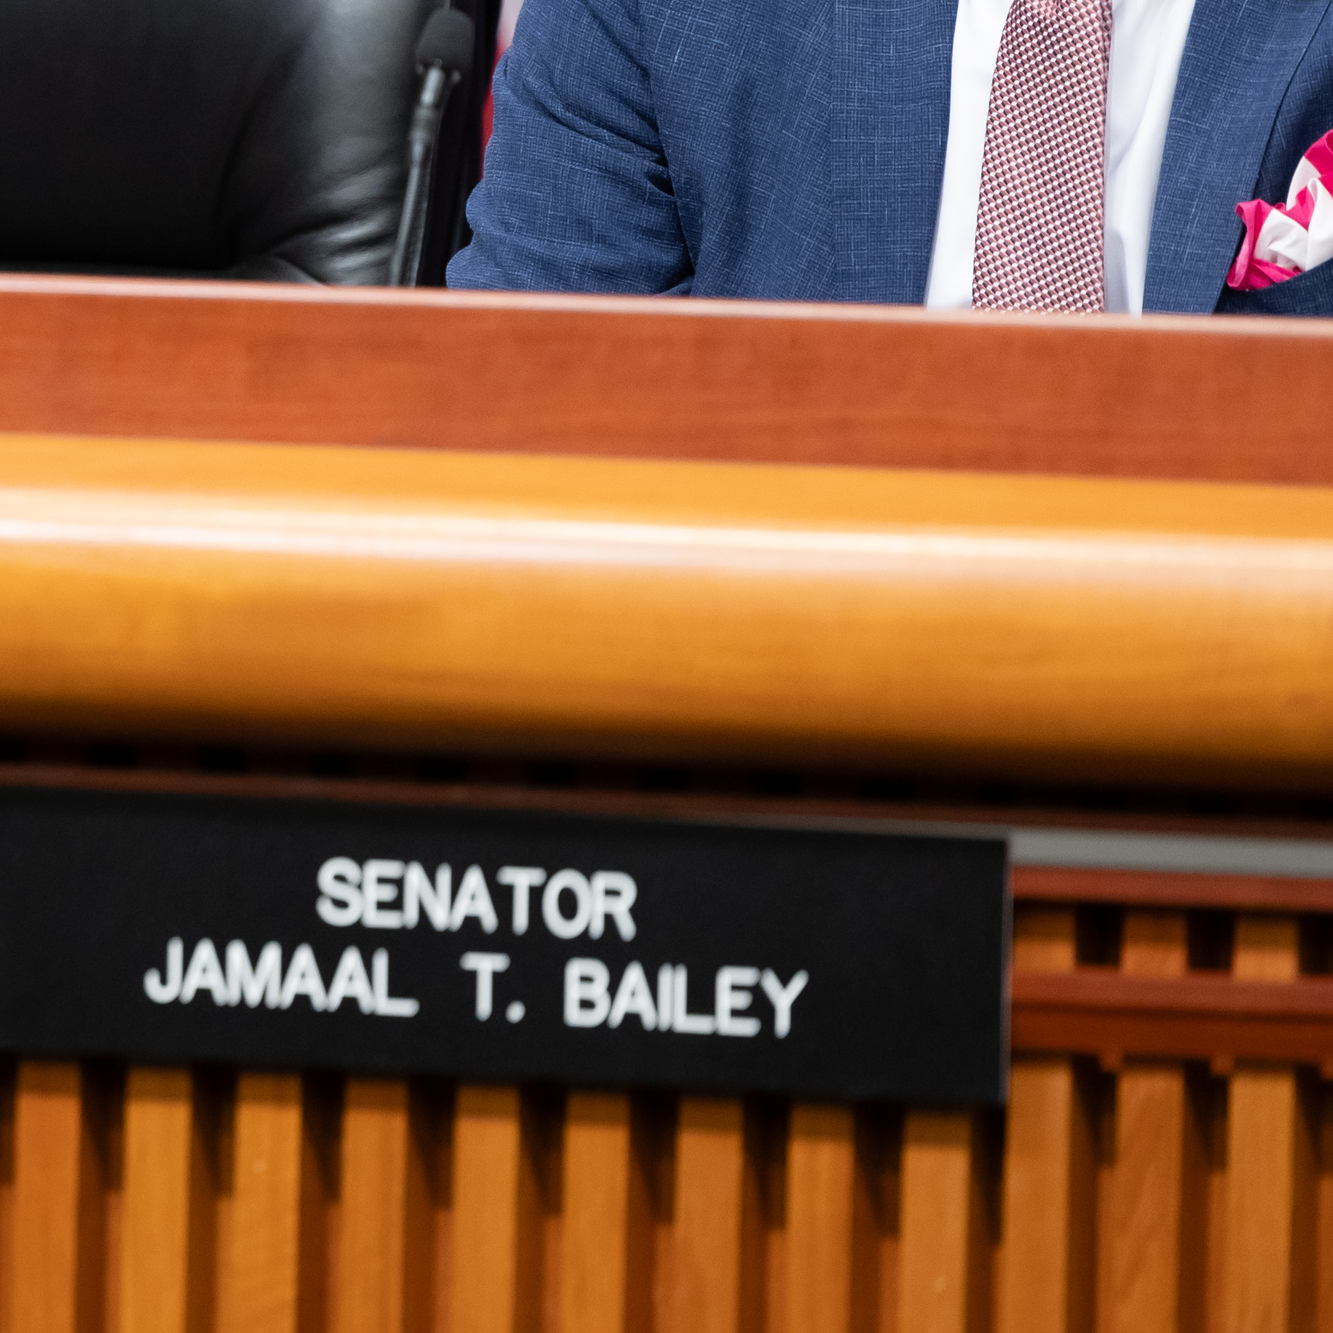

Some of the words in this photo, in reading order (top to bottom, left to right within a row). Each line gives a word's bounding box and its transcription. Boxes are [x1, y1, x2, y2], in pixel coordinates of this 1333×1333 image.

[316, 856, 638, 941] SENATOR
[143, 937, 420, 1018] JAMAAL
[460, 951, 526, 1023] T.
[563, 957, 809, 1038] BAILEY
